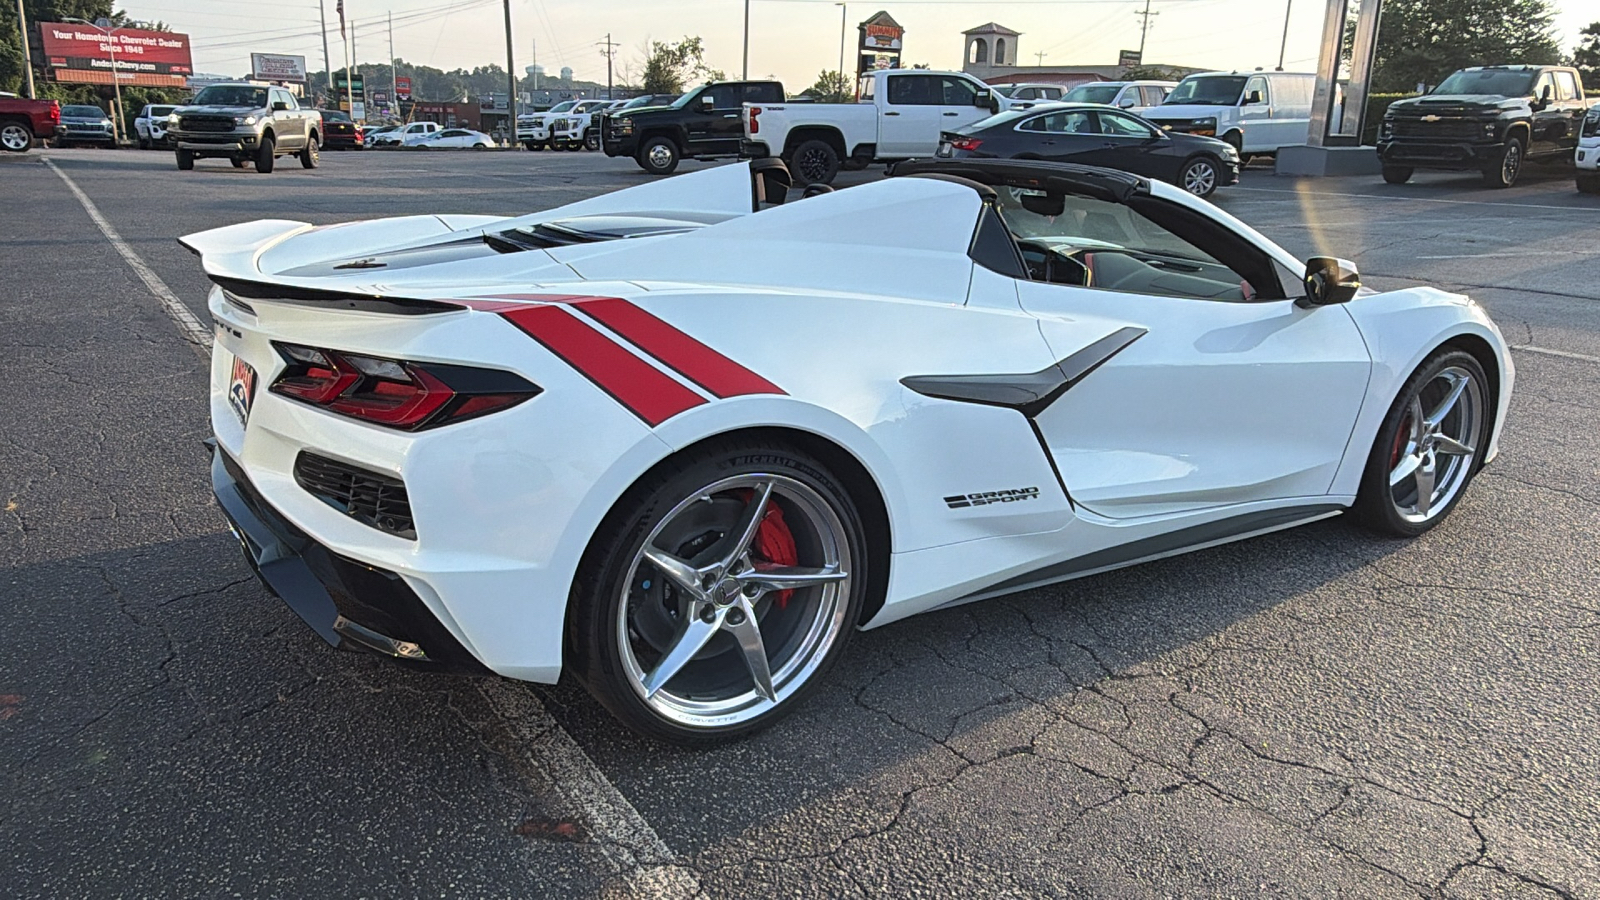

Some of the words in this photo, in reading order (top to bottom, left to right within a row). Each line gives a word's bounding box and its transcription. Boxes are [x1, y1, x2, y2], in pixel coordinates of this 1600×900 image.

[867, 24, 901, 40] SUMMITS
[52, 30, 73, 40] Your
[74, 31, 119, 43] Hometown
[119, 35, 157, 46] Chevrolet
[158, 38, 183, 49] Dealer
[99, 43, 122, 53] Since
[124, 45, 144, 55] 1948
[735, 455, 797, 468] MICHELIN
[967, 486, 1039, 500] GRAND
[971, 493, 1040, 506] SPORT
[677, 714, 738, 723] CORVETTE
